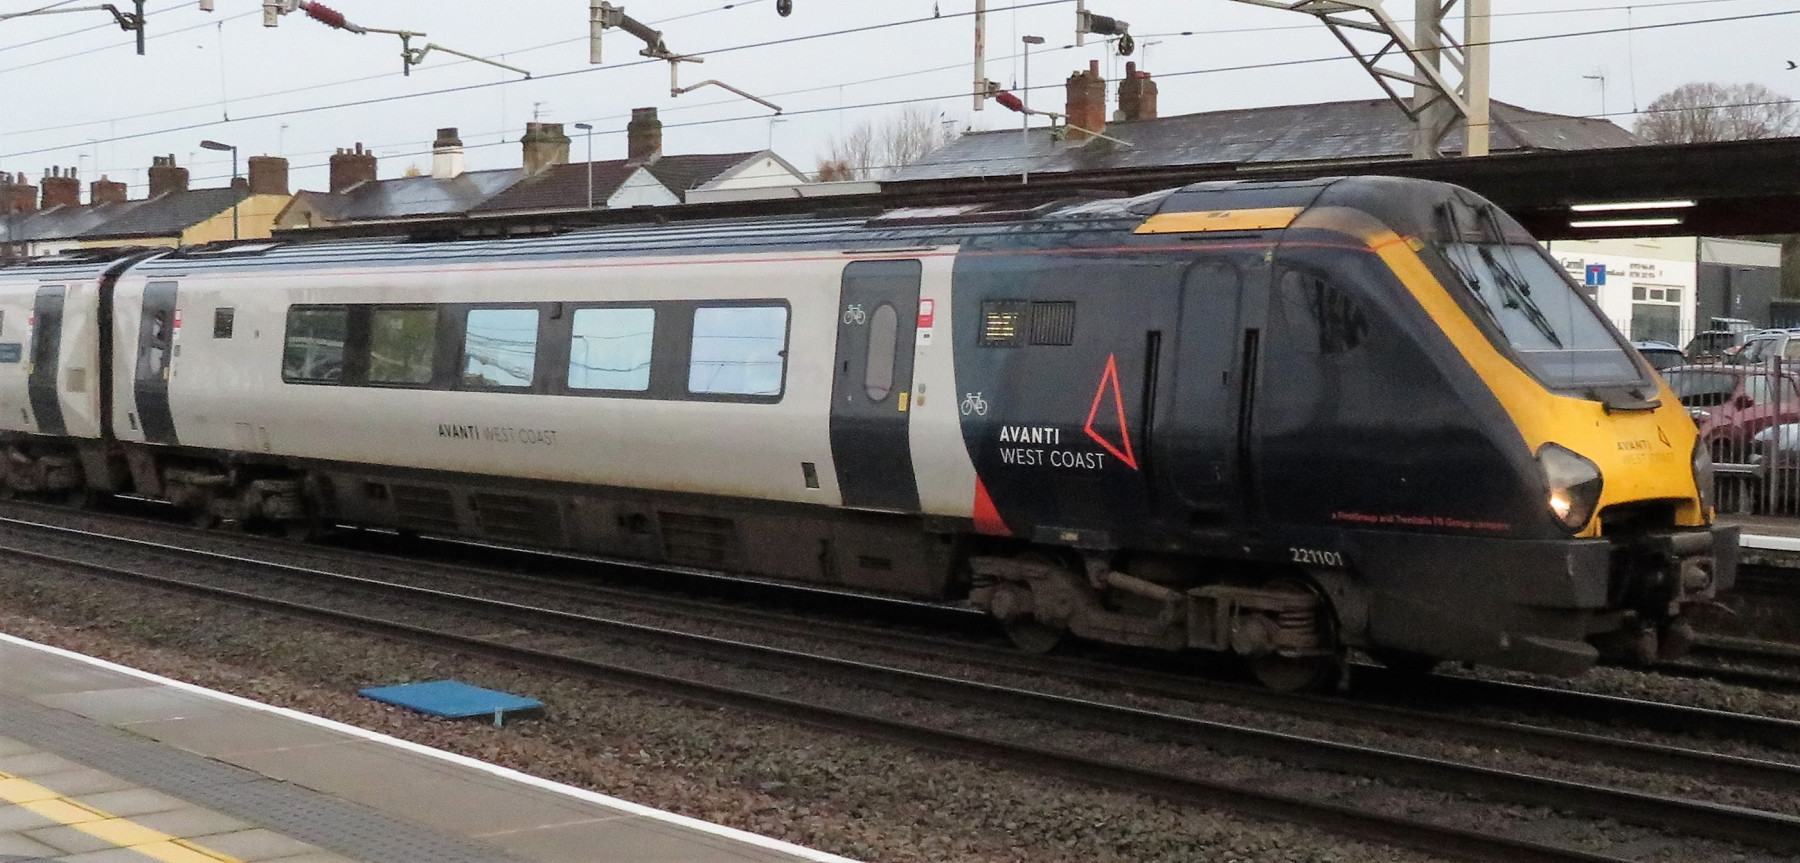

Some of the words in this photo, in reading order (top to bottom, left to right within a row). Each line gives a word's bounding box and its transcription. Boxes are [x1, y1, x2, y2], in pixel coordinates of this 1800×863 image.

[439, 424, 479, 440] AVANTI
[483, 427, 514, 442] WEST
[519, 429, 556, 446] COAST
[1000, 425, 1059, 444] AVANTI
[1000, 448, 1043, 465] WEST
[1050, 450, 1105, 469] COAST
[1289, 547, 1343, 566] 221101
